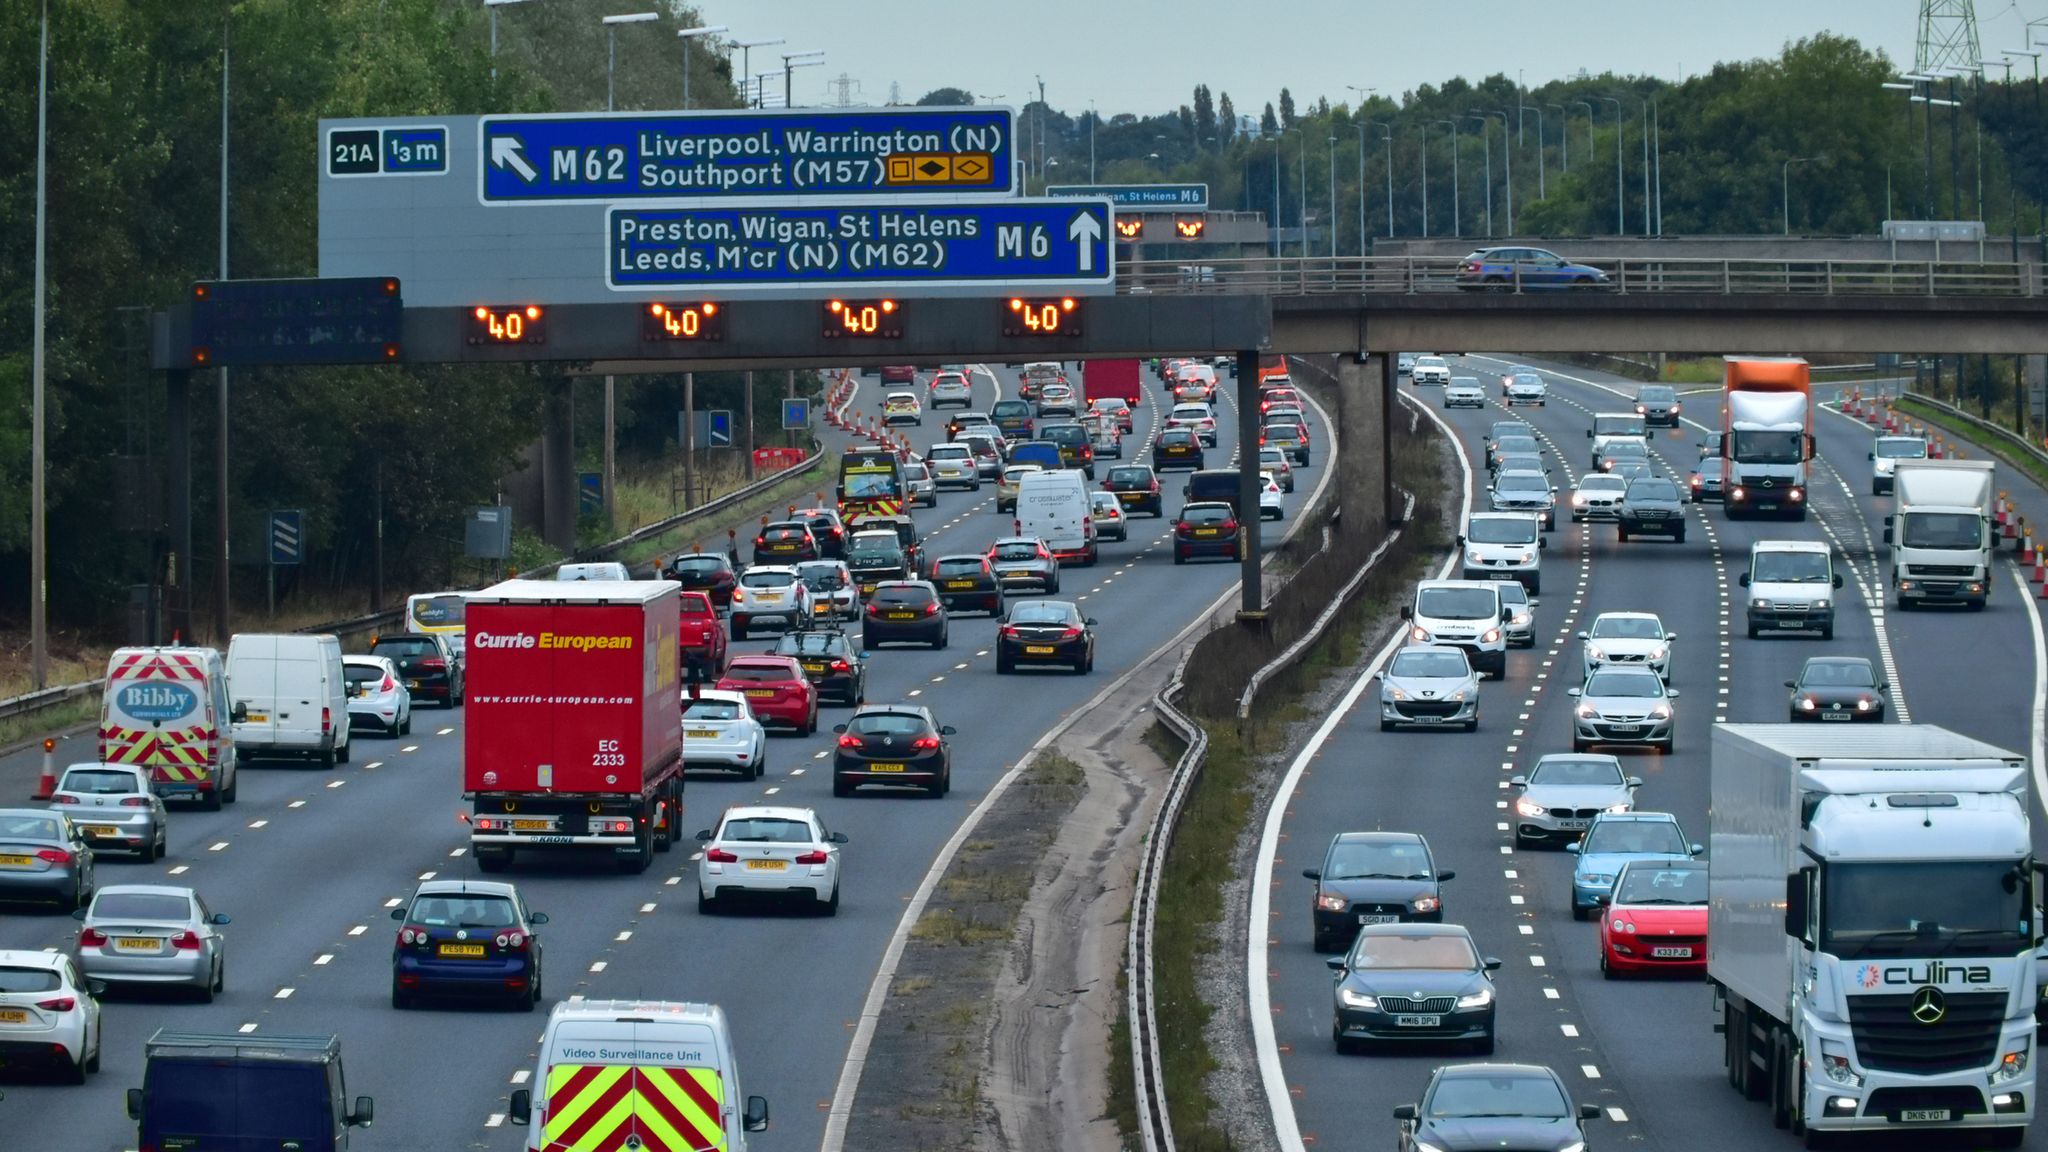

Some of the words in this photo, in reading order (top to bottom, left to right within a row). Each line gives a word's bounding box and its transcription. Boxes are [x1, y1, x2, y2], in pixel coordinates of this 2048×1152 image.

[335, 144, 374, 164] 21A
[639, 131, 780, 160] Liverpool,
[786, 130, 940, 157] Warrington
[950, 125, 1001, 153] (N)
[552, 148, 625, 182] M62
[641, 162, 782, 190] Southport
[793, 157, 885, 185] (M57)
[1130, 193, 1140, 201] St
[1143, 192, 1177, 201] Helens
[1180, 190, 1200, 202] M6
[620, 216, 736, 242] Preston,
[741, 215, 833, 243] Wigan,
[839, 214, 870, 238] St
[881, 214, 977, 237] Helens
[998, 225, 1049, 258] M6
[620, 246, 711, 272] Leeds,
[718, 246, 777, 270] M'cr
[788, 244, 839, 270] (N)
[849, 240, 945, 268] (M62)
[488, 313, 523, 340] 40
[665, 310, 698, 336] 40
[844, 307, 877, 333] 40
[1024, 305, 1057, 331] 40
[474, 631, 535, 649] Currie
[538, 632, 633, 653] European
[126, 687, 189, 711] Bibby
[474, 694, 633, 705] www.currie-european.com
[598, 740, 619, 752] EC
[592, 754, 625, 767] 2333
[539, 836, 574, 844] KRONE
[1381, 916, 1395, 924] AUF
[1883, 960, 1991, 985] culina
[1401, 1016, 1418, 1025] MM16
[1421, 1016, 1437, 1025] DPU
[563, 1048, 596, 1059] Video
[600, 1049, 673, 1061] Surveillance
[677, 1051, 701, 1061] Unit
[1906, 1111, 1926, 1120] DK16
